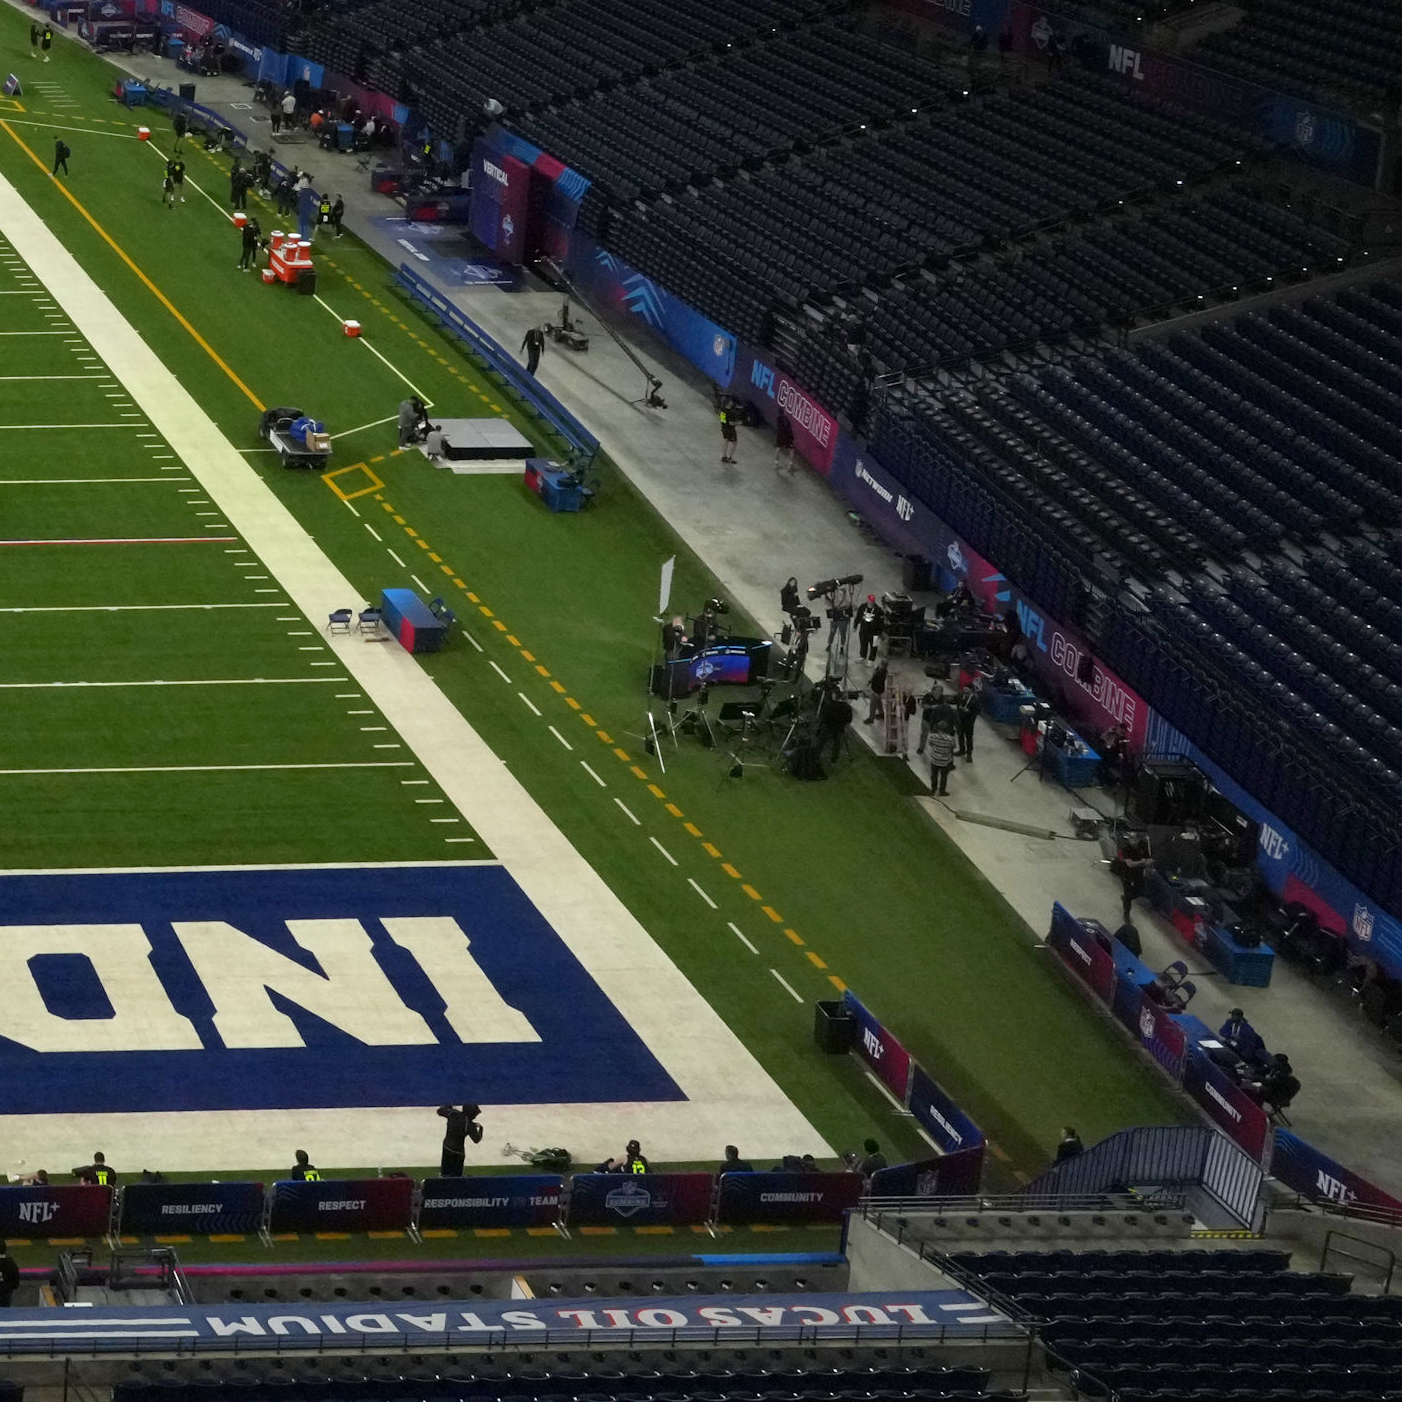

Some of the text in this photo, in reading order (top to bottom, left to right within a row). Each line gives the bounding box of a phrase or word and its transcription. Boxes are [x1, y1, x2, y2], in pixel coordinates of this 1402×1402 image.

[1108, 44, 1145, 81] NFL
[483, 158, 509, 187] VERTICAL
[751, 358, 832, 450] NFL COMBINE
[860, 467, 894, 504] NETWORK
[1015, 598, 1136, 734] NFL COBINE
[1259, 821, 1291, 861] NFL+
[18, 1201, 61, 1224] NFL+
[160, 1203, 224, 1215] RESILIENCY
[317, 1200, 367, 1212] RESPECT
[423, 1196, 560, 1209] RESPONSIBILITY TEAM
[759, 1192, 825, 1204] COMMUNITY
[205, 1304, 938, 1337] LUCAS OIL STADIUM
